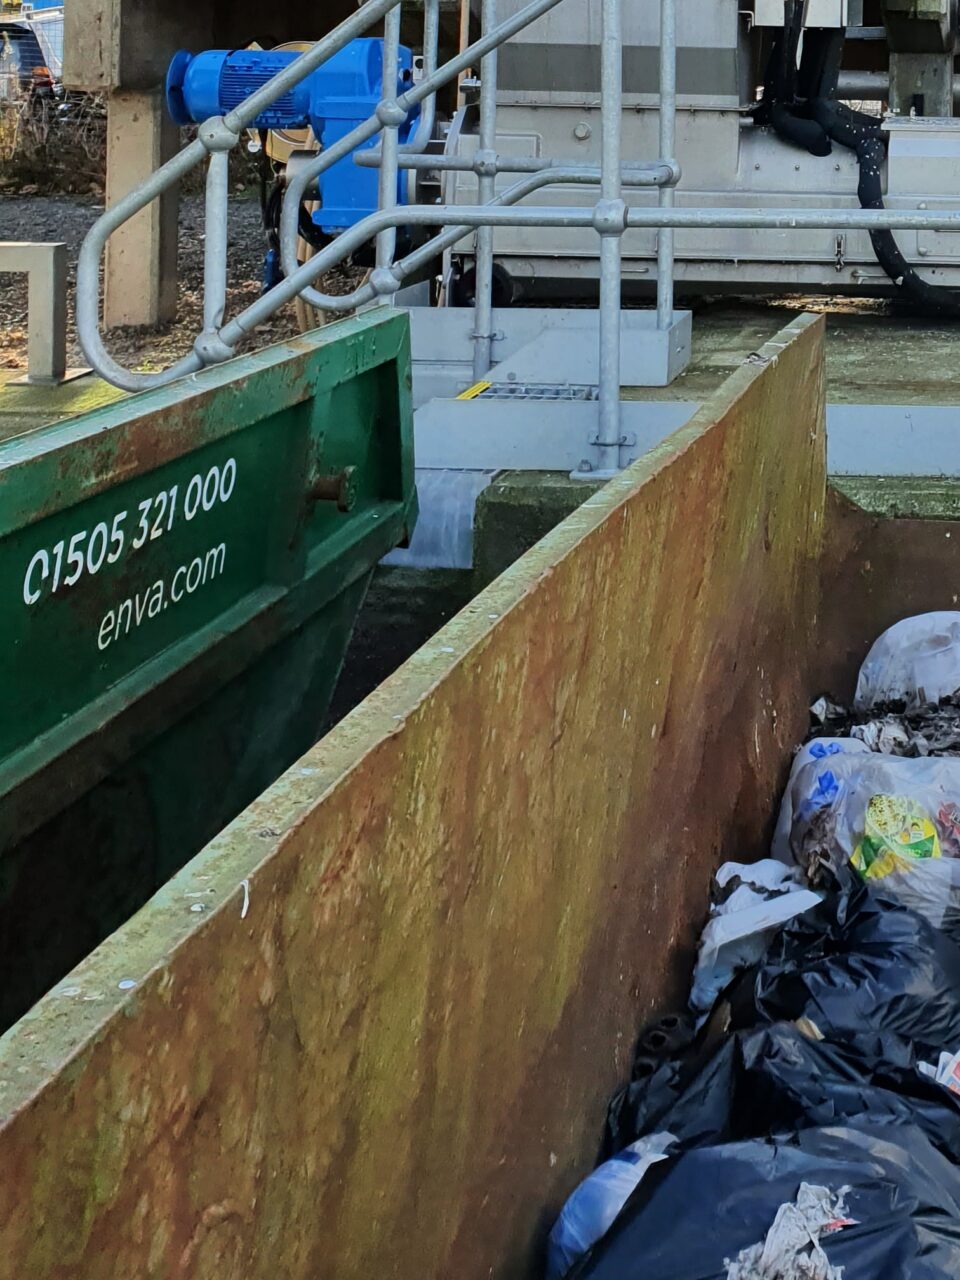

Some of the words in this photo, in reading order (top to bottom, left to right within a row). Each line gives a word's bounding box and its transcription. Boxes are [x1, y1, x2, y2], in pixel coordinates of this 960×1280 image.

[133, 484, 179, 549] 321
[184, 457, 237, 521] 000
[97, 542, 227, 650] enva.com
